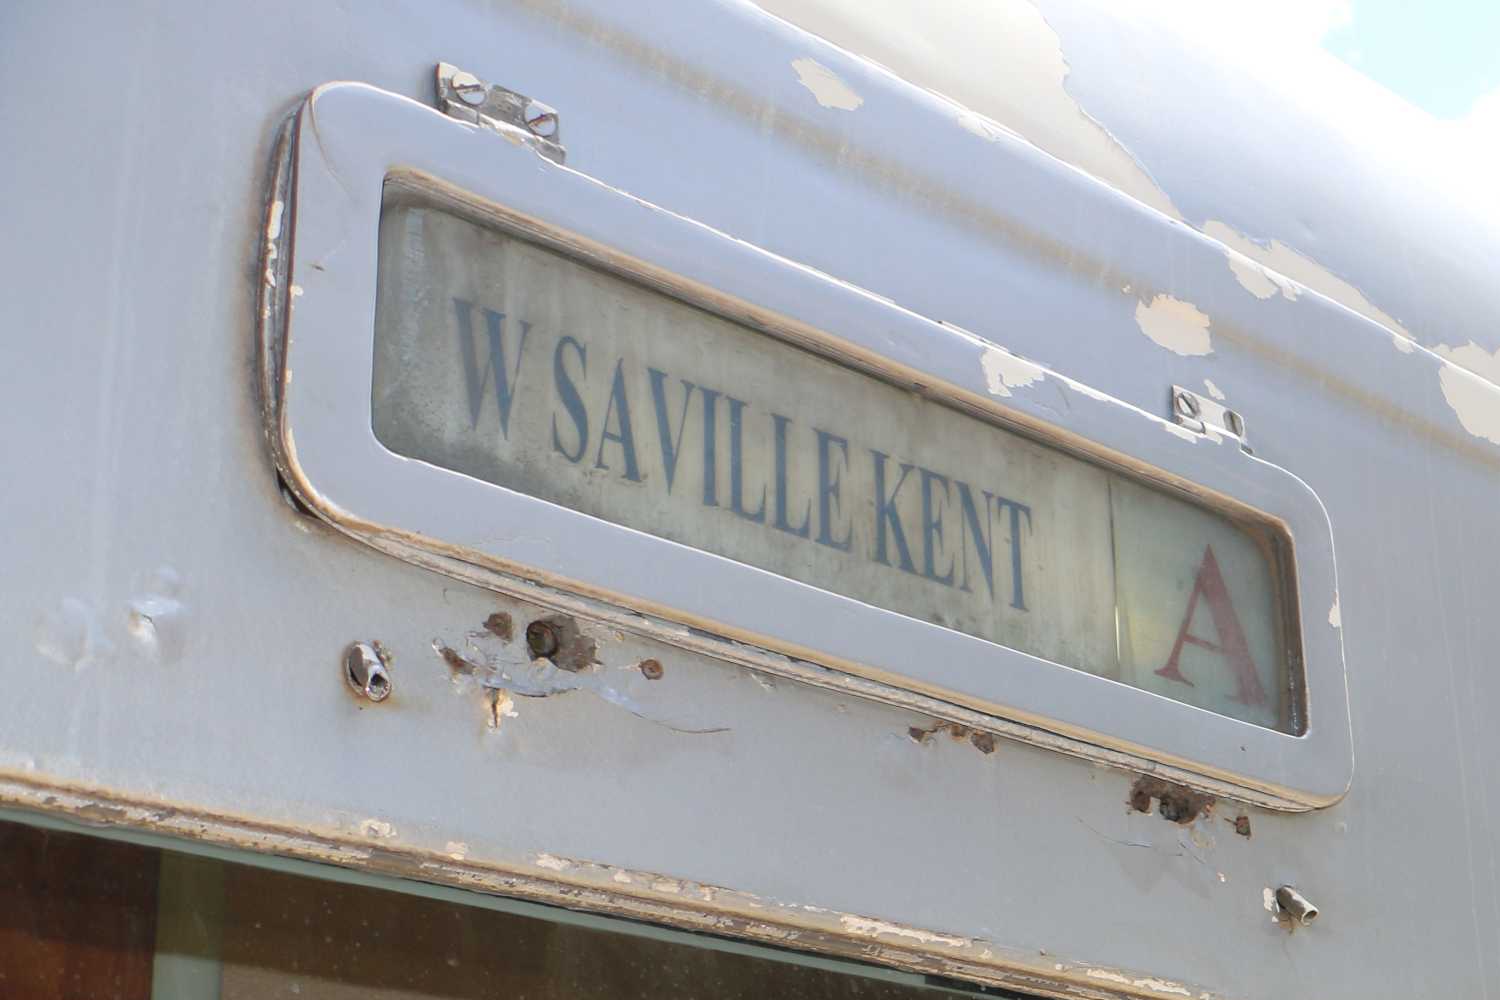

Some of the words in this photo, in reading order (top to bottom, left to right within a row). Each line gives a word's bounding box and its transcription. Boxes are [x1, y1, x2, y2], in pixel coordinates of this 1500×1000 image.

[453, 297, 533, 441] W
[552, 335, 850, 553] SAVILLE
[868, 449, 1033, 612] KENT
[1153, 544, 1267, 706] A
